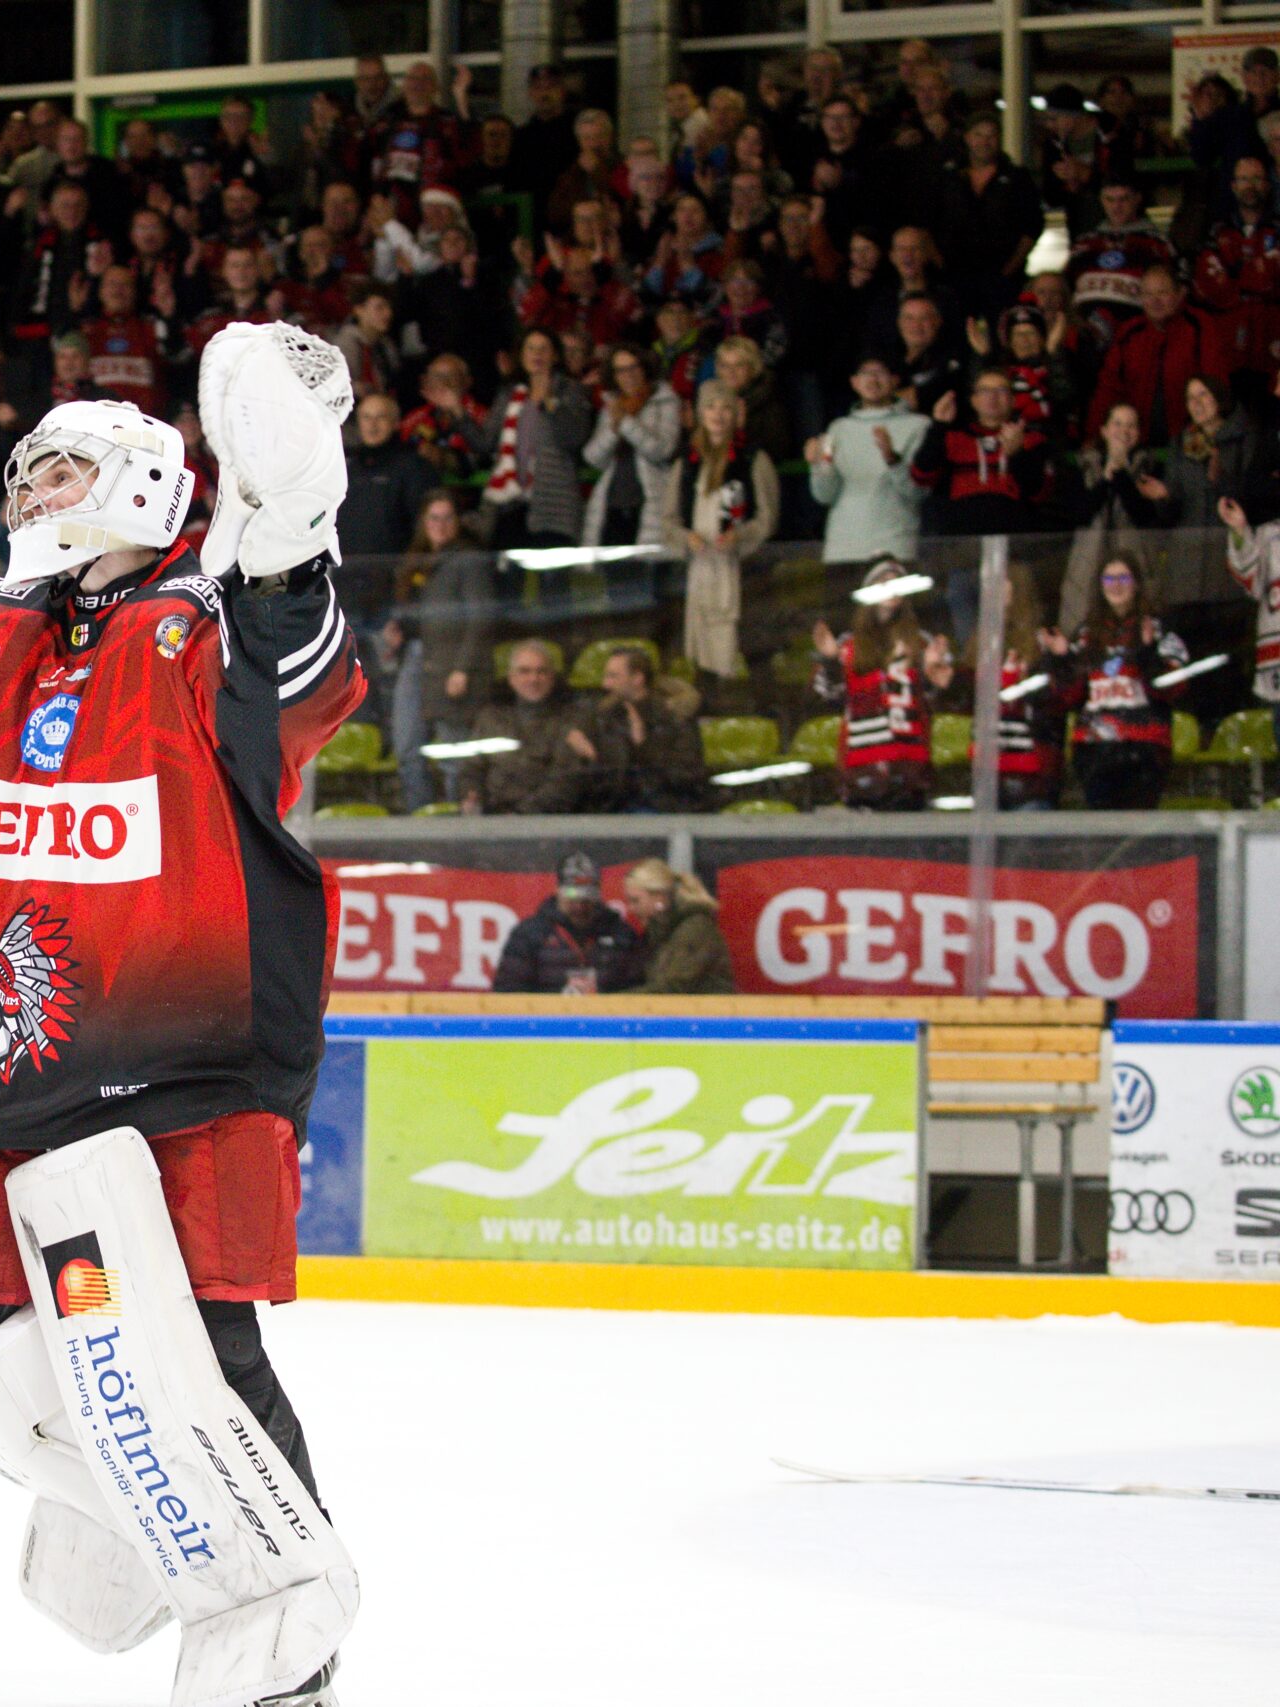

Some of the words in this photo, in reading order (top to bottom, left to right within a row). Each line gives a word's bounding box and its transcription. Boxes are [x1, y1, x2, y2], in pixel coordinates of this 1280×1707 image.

[164, 472, 187, 533] BAUER
[754, 886, 1151, 998] GEFRO
[478, 1214, 904, 1252] www.autohaus-seitz.de
[66, 1338, 95, 1418] Heizung
[95, 1437, 135, 1498] Sanitär
[138, 1515, 179, 1578] Service
[85, 1325, 216, 1563] höflmeir
[190, 1424, 282, 1558] BAUER
